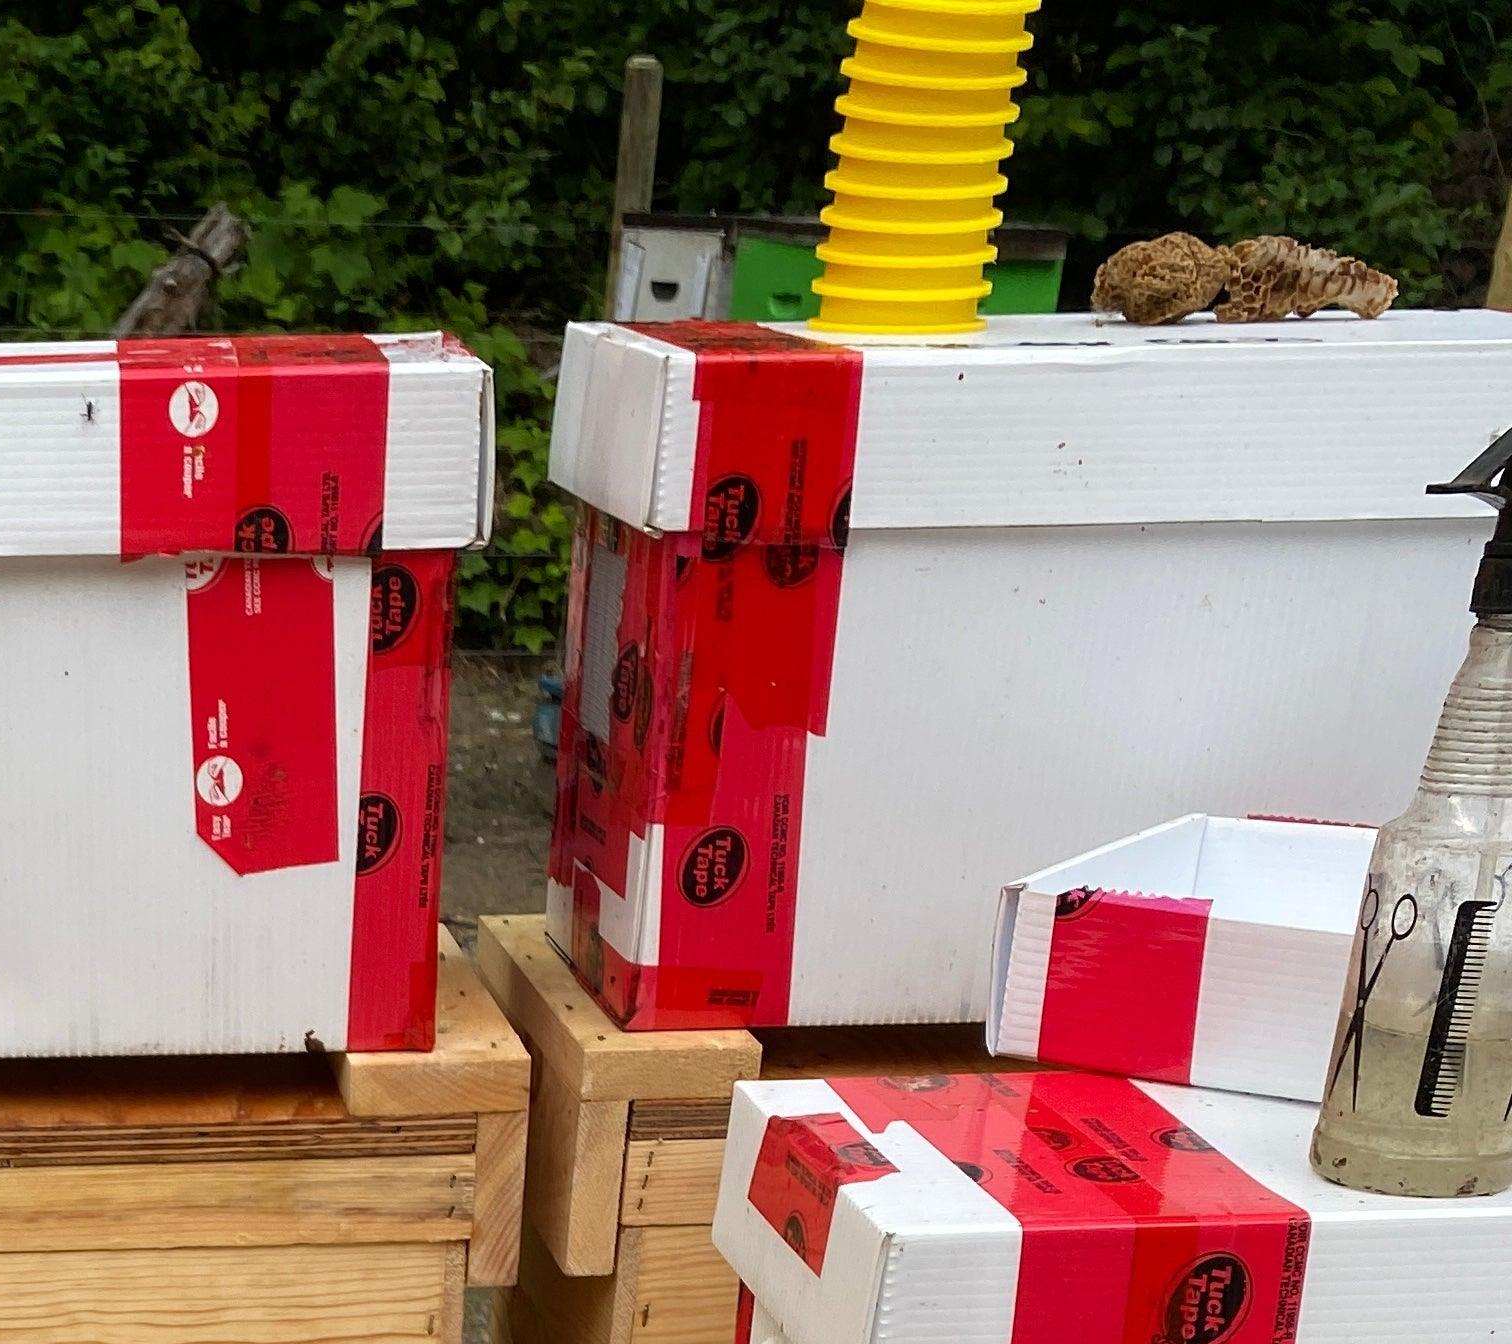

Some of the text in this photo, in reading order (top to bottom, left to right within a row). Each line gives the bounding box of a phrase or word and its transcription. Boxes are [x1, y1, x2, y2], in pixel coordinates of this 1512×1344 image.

[386, 575, 402, 633] Tape
[366, 802, 384, 858] Tuck
[693, 843, 713, 899] Tape
[713, 836, 732, 891] Tuck
[1180, 1274, 1208, 1341] Tape
[1203, 1264, 1232, 1336] Tuck
